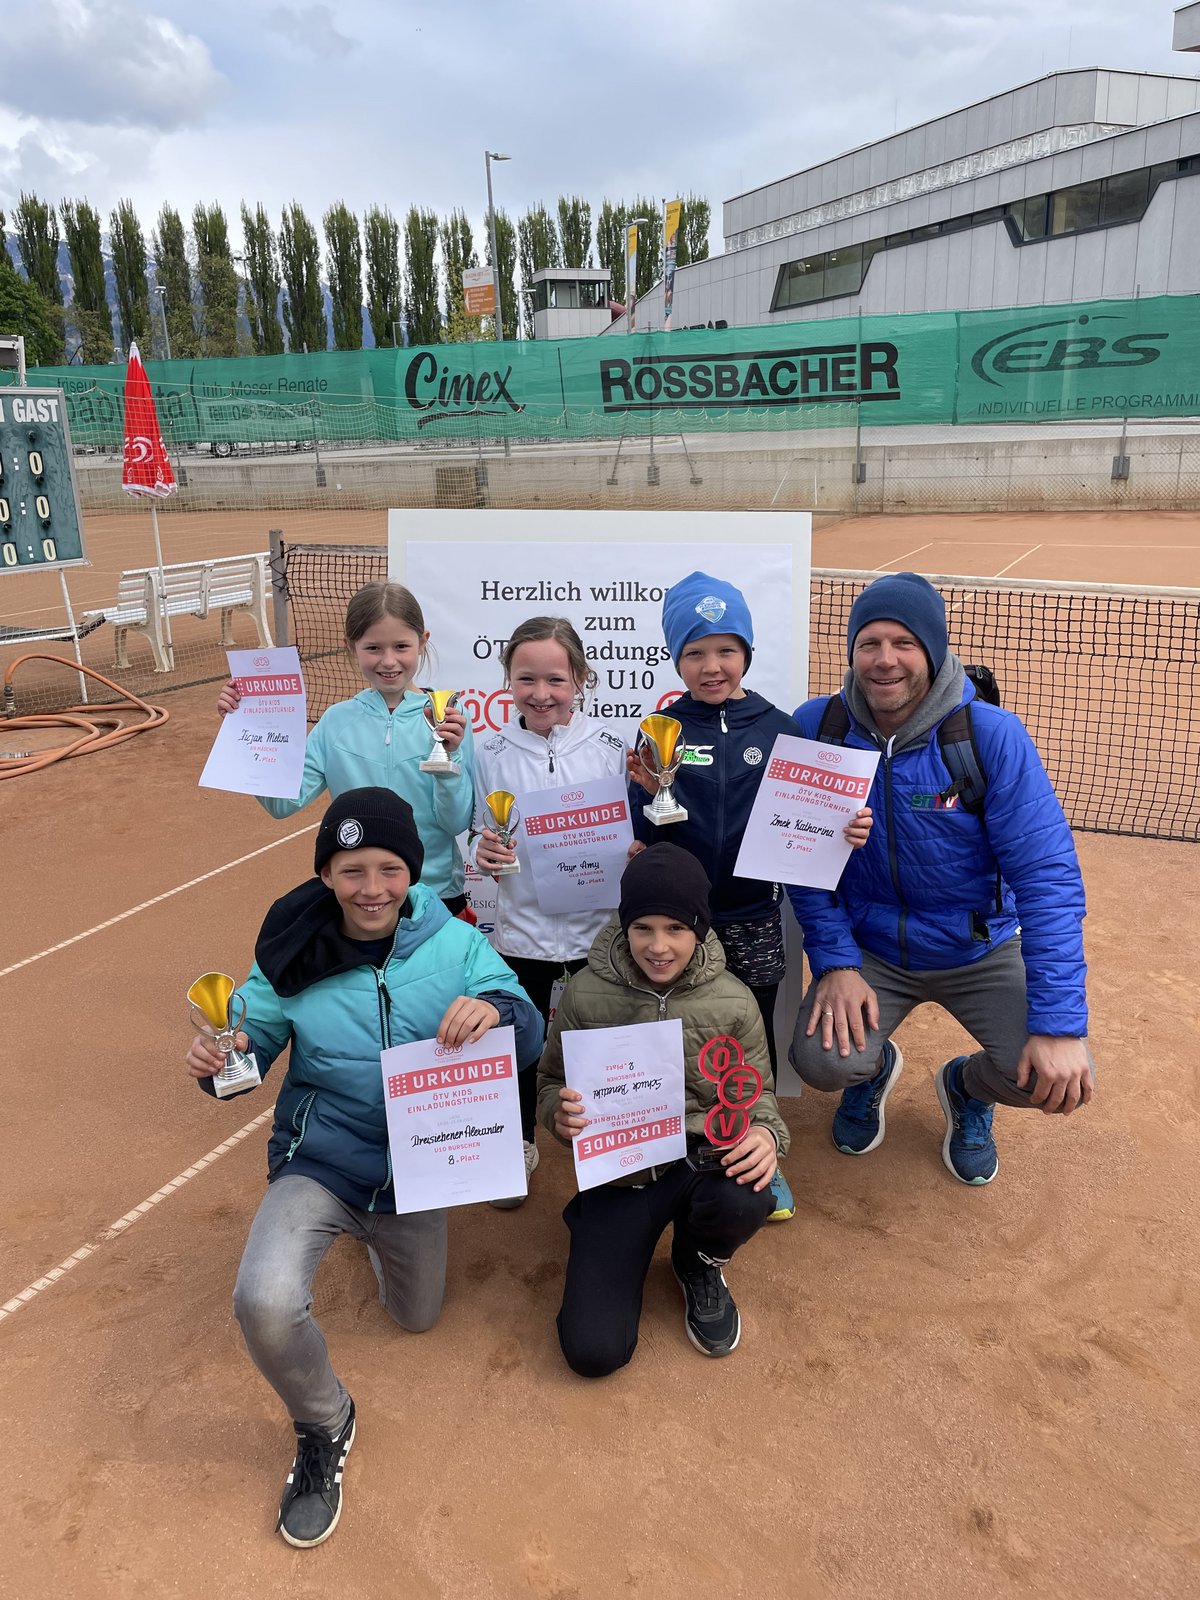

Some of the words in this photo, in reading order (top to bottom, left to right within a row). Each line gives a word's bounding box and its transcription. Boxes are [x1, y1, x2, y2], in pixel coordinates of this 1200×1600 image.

[992, 333, 1169, 373] EBS
[405, 352, 526, 413] Cinex
[600, 342, 900, 403] ROSSBACHER
[231, 380, 273, 397] Moser
[278, 376, 328, 393] Renate
[13, 398, 58, 423] GAST
[977, 399, 1087, 415] INDIVIDUELLE
[1091, 392, 1200, 409] PROGRAMMI
[481, 581, 581, 602] Herzlich
[590, 581, 669, 602] willko
[584, 616, 636, 631] zum
[473, 635, 511, 660] ÖT
[245, 678, 299, 693] URKUNDE
[607, 670, 655, 690] U10
[789, 767, 866, 796] URKUNDE
[774, 790, 851, 814] EINLADUNGSTURNIER
[798, 787, 814, 797] ÖTV
[815, 790, 832, 801] KIDS
[546, 807, 620, 829] URKUNDE
[793, 818, 834, 837] Katharina
[543, 834, 617, 849] EINLADUNGSTURNIER
[563, 831, 576, 840] ÖTV
[579, 831, 595, 839] KIDS
[580, 860, 600, 871] Amy
[413, 1061, 505, 1088] URKUNDE
[407, 1093, 499, 1113] EINLADUNGSTURNIER
[432, 1092, 449, 1101] ÖTV
[452, 1088, 473, 1098] KIDS
[587, 1104, 668, 1126] EINLADUNGSTURNIER
[611, 1118, 628, 1128] KIDS
[629, 1115, 646, 1124] ÖTV
[434, 1145, 447, 1153] U10
[448, 1142, 481, 1151] BURSCHEN
[583, 1125, 660, 1154] URKUNDE
